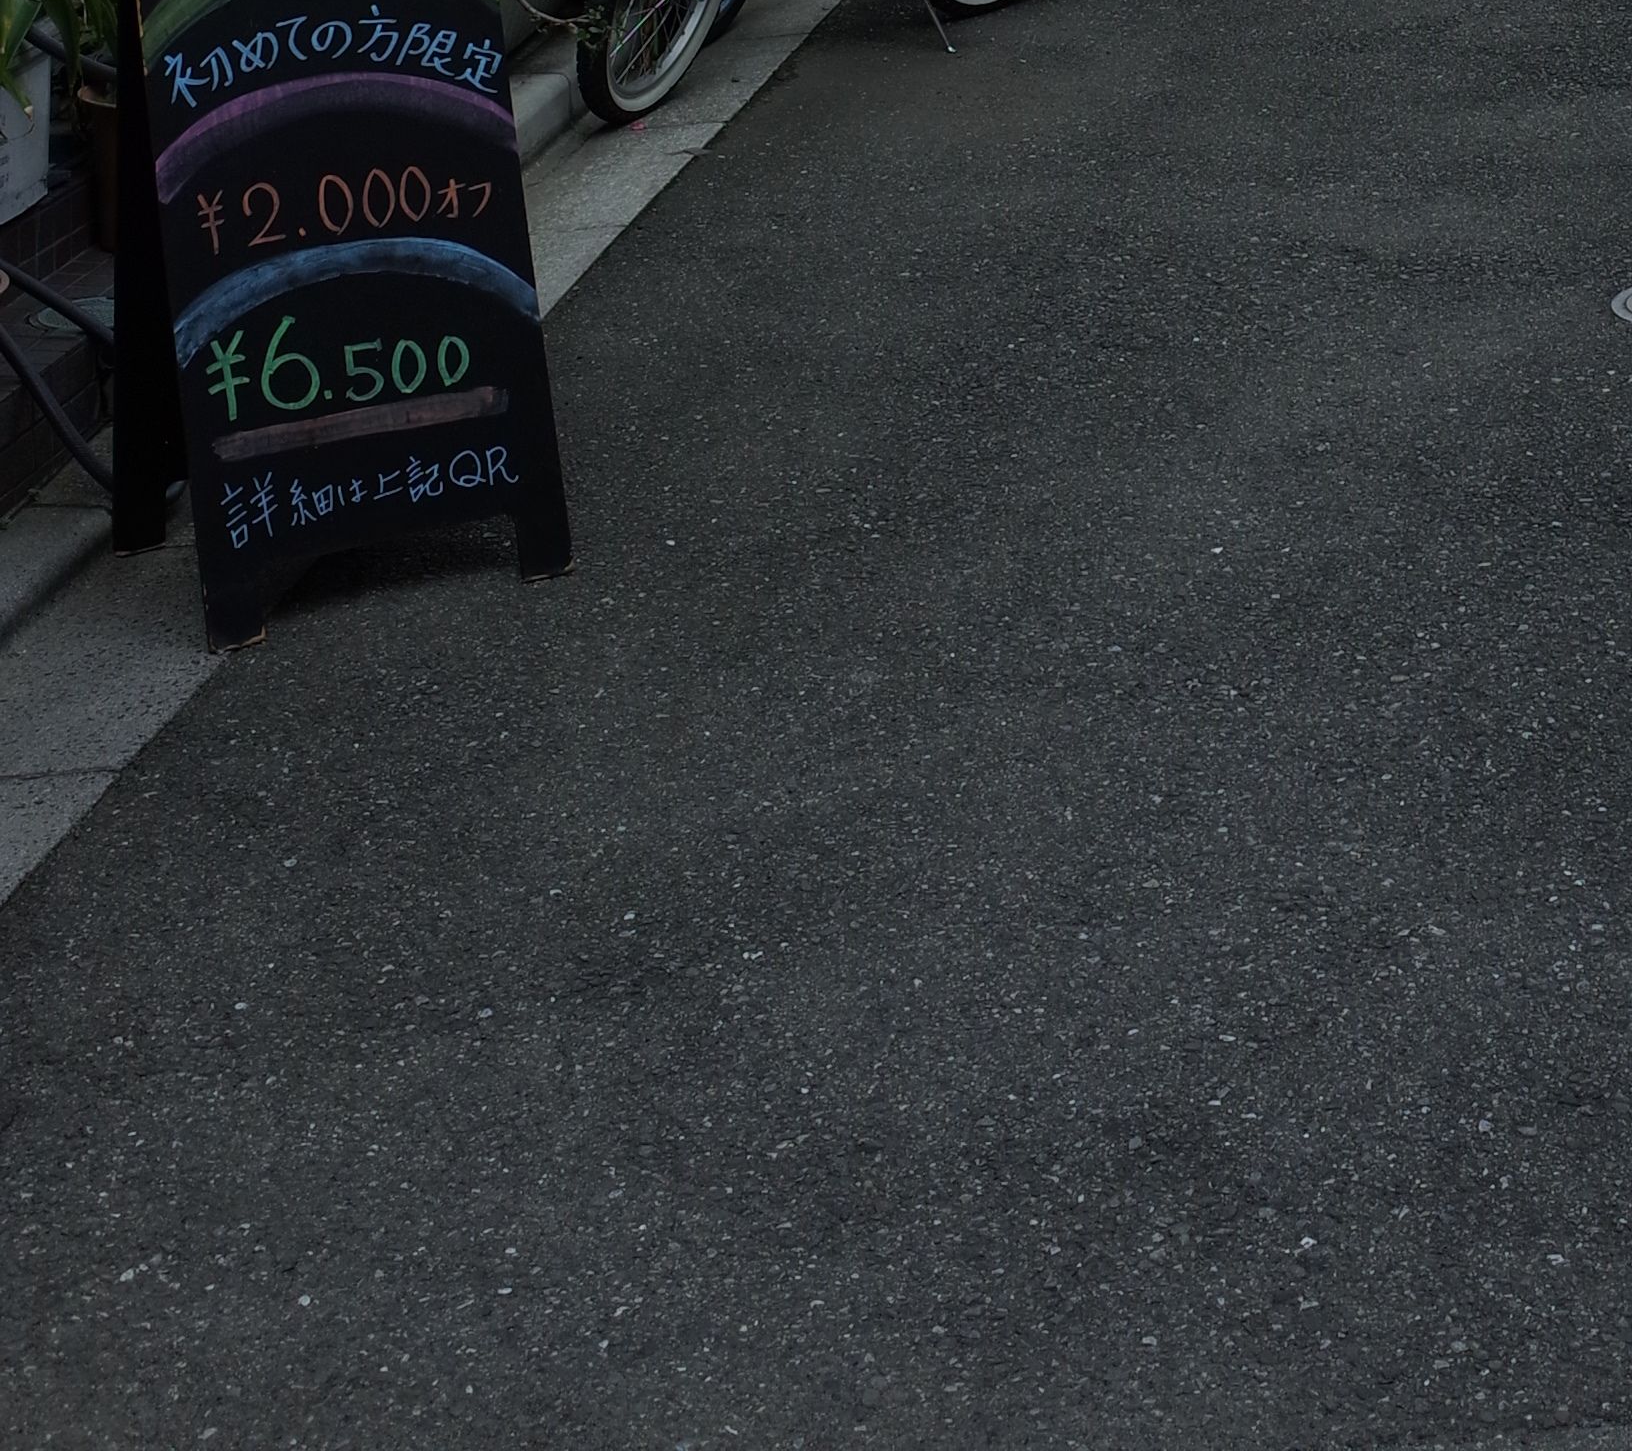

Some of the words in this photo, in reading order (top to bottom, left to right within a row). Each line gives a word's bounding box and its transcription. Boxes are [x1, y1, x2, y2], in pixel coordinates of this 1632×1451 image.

[164, 4, 503, 108] 初めての方限定
[206, 315, 470, 421] ¥6.500
